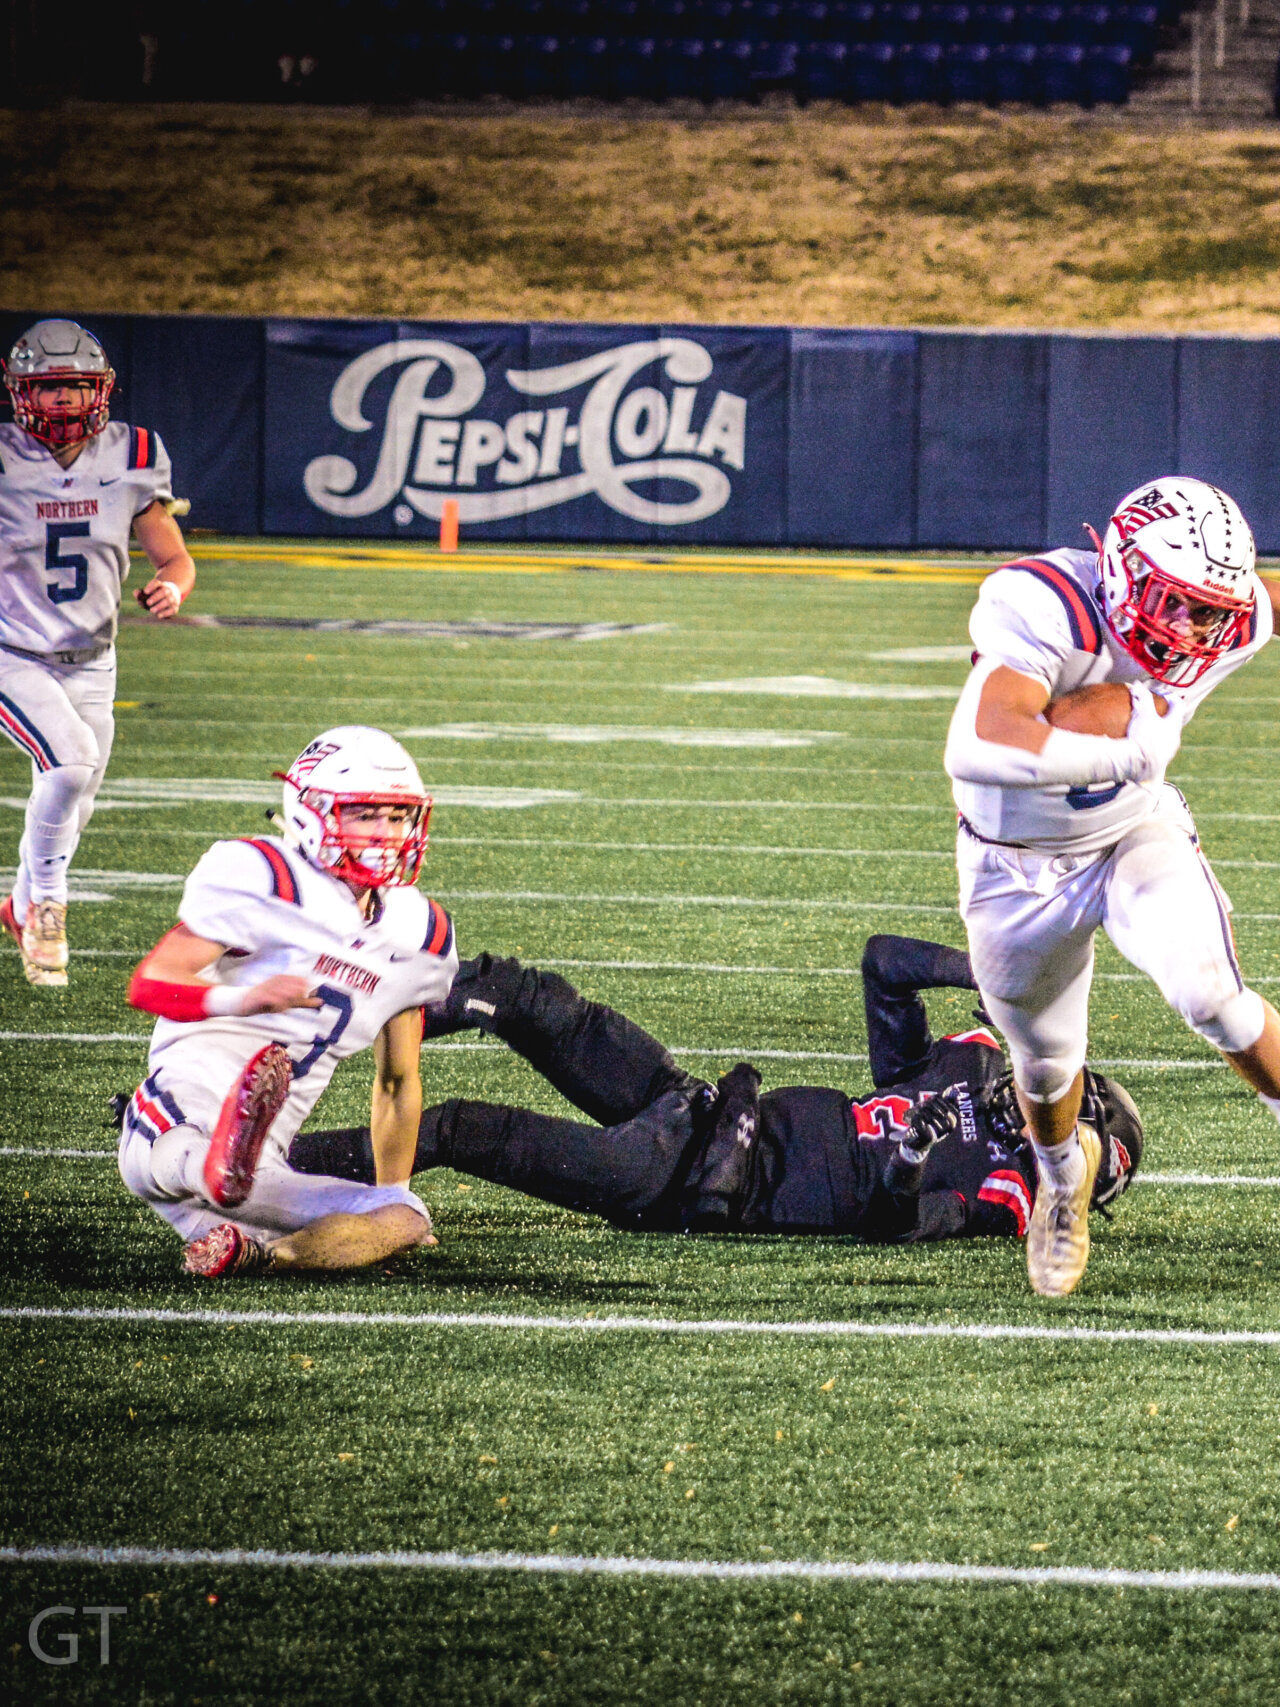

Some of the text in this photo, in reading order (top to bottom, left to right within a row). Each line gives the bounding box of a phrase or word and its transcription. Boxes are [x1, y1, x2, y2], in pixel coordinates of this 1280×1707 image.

[36, 499, 98, 519] NORTHERN
[45, 521, 90, 605] 5
[312, 952, 382, 997] NORTHERN
[953, 1080, 978, 1142] LANCERS
